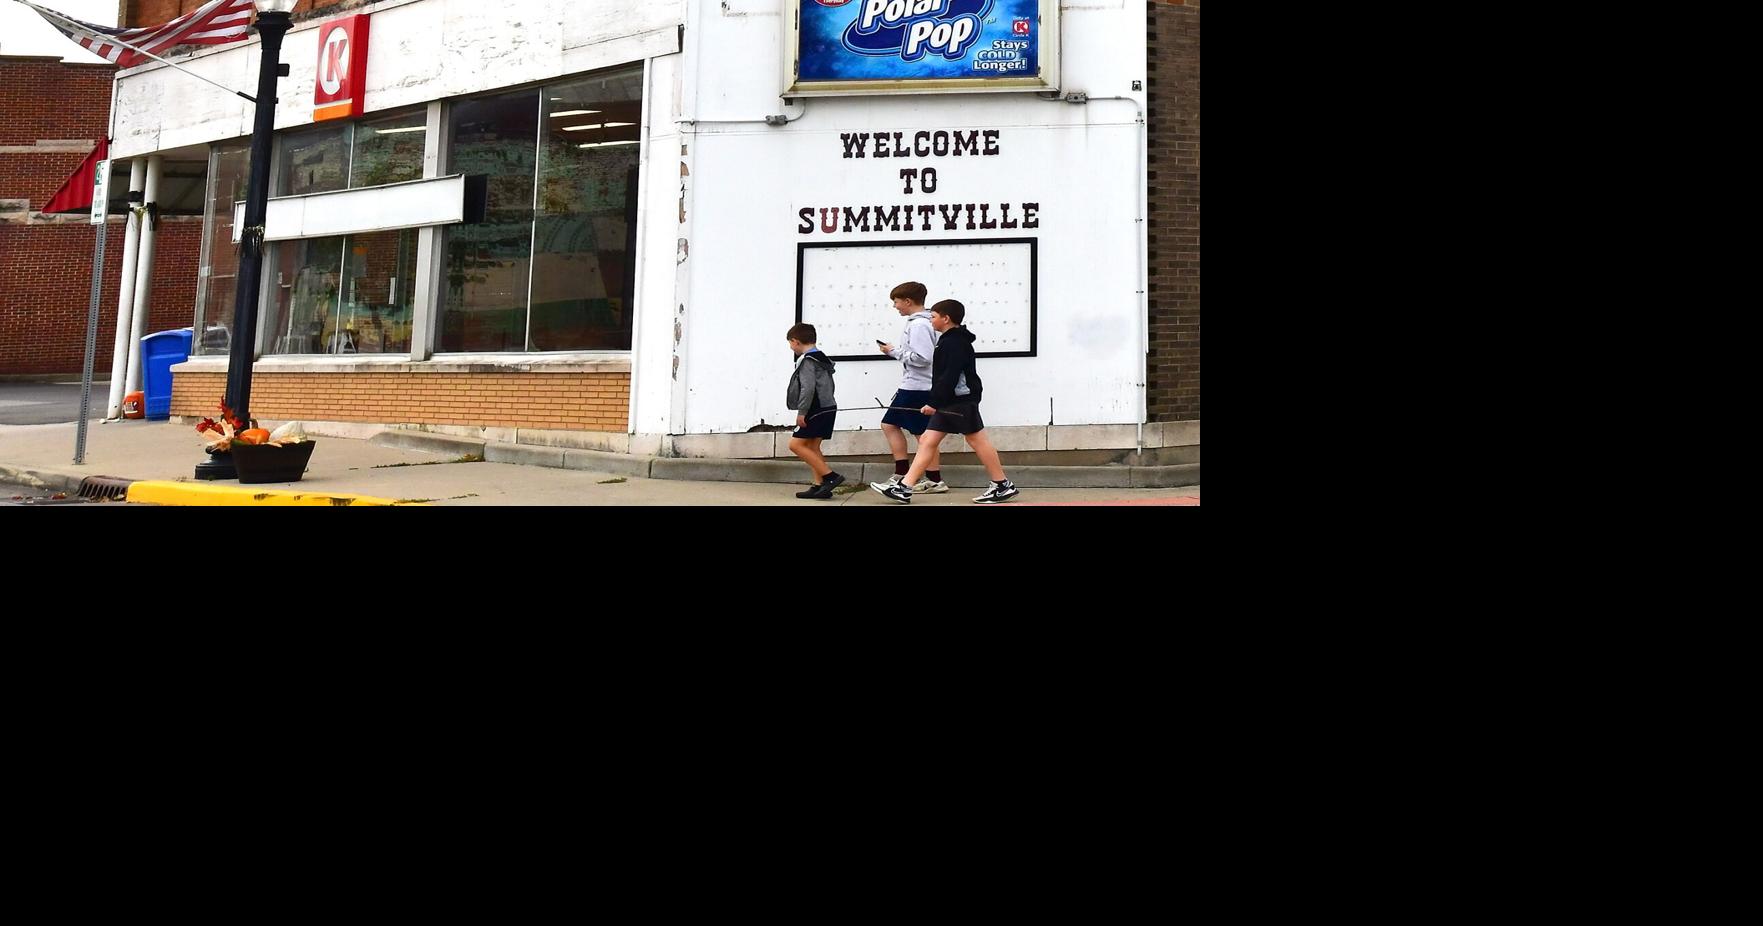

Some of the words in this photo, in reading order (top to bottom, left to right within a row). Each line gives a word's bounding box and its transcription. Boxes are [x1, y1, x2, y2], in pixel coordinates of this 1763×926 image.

[906, 17, 974, 55] Pop
[992, 39, 1028, 51] Stays
[973, 58, 1027, 72] Longer!
[978, 50, 1016, 60] COLD
[840, 130, 1000, 158] WELCOME
[900, 167, 937, 194] TO
[798, 203, 1039, 234] SUMMITVILLE
